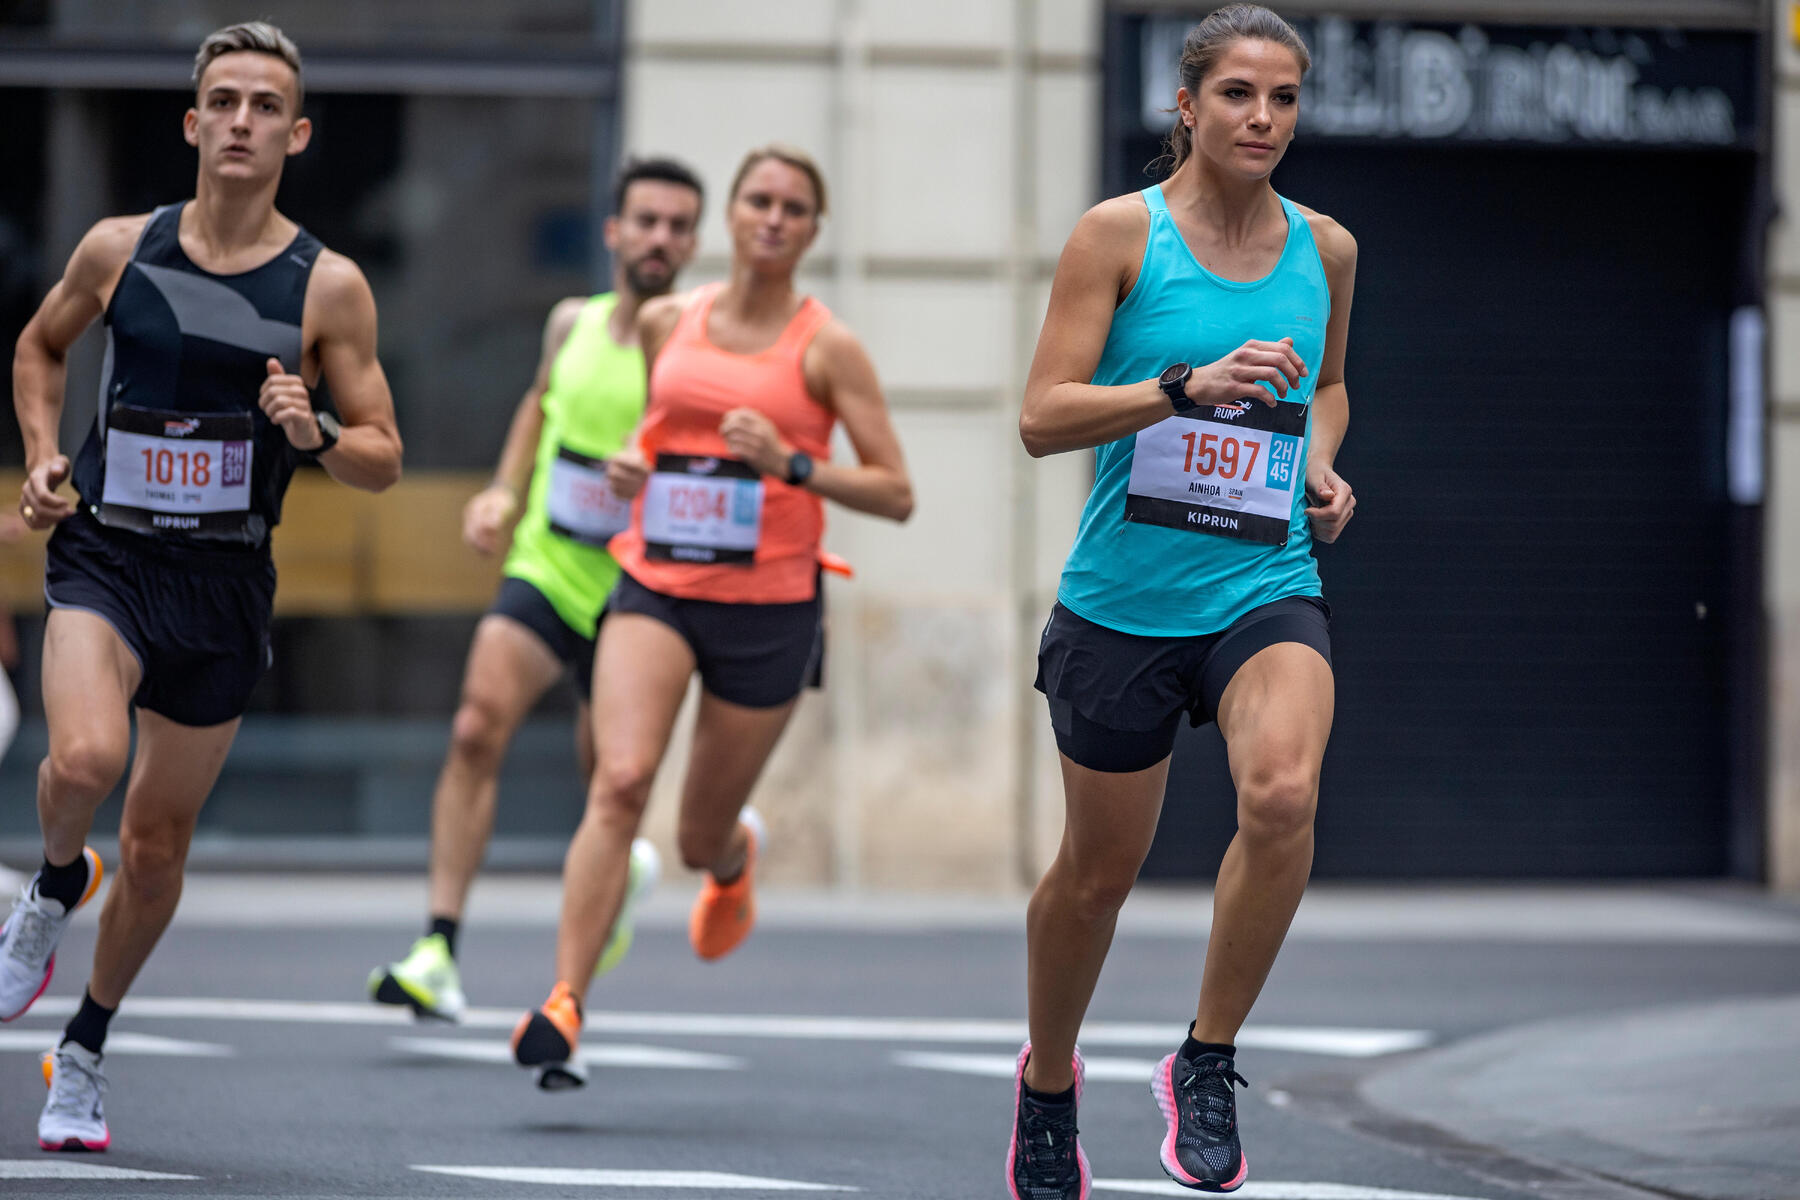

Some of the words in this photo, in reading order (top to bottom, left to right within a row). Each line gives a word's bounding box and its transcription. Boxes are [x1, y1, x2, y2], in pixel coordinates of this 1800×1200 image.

[225, 446, 244, 465] 2H
[1181, 431, 1261, 482] 1597
[1271, 440, 1294, 461] 2H
[141, 448, 211, 487] 1018
[223, 466, 243, 482] 30
[1269, 461, 1290, 482] 45
[1188, 482, 1221, 497] AINHOA
[1228, 487, 1244, 497] SPAIN
[152, 514, 200, 529] KIPRUN
[1187, 511, 1238, 530] KIPRUN
